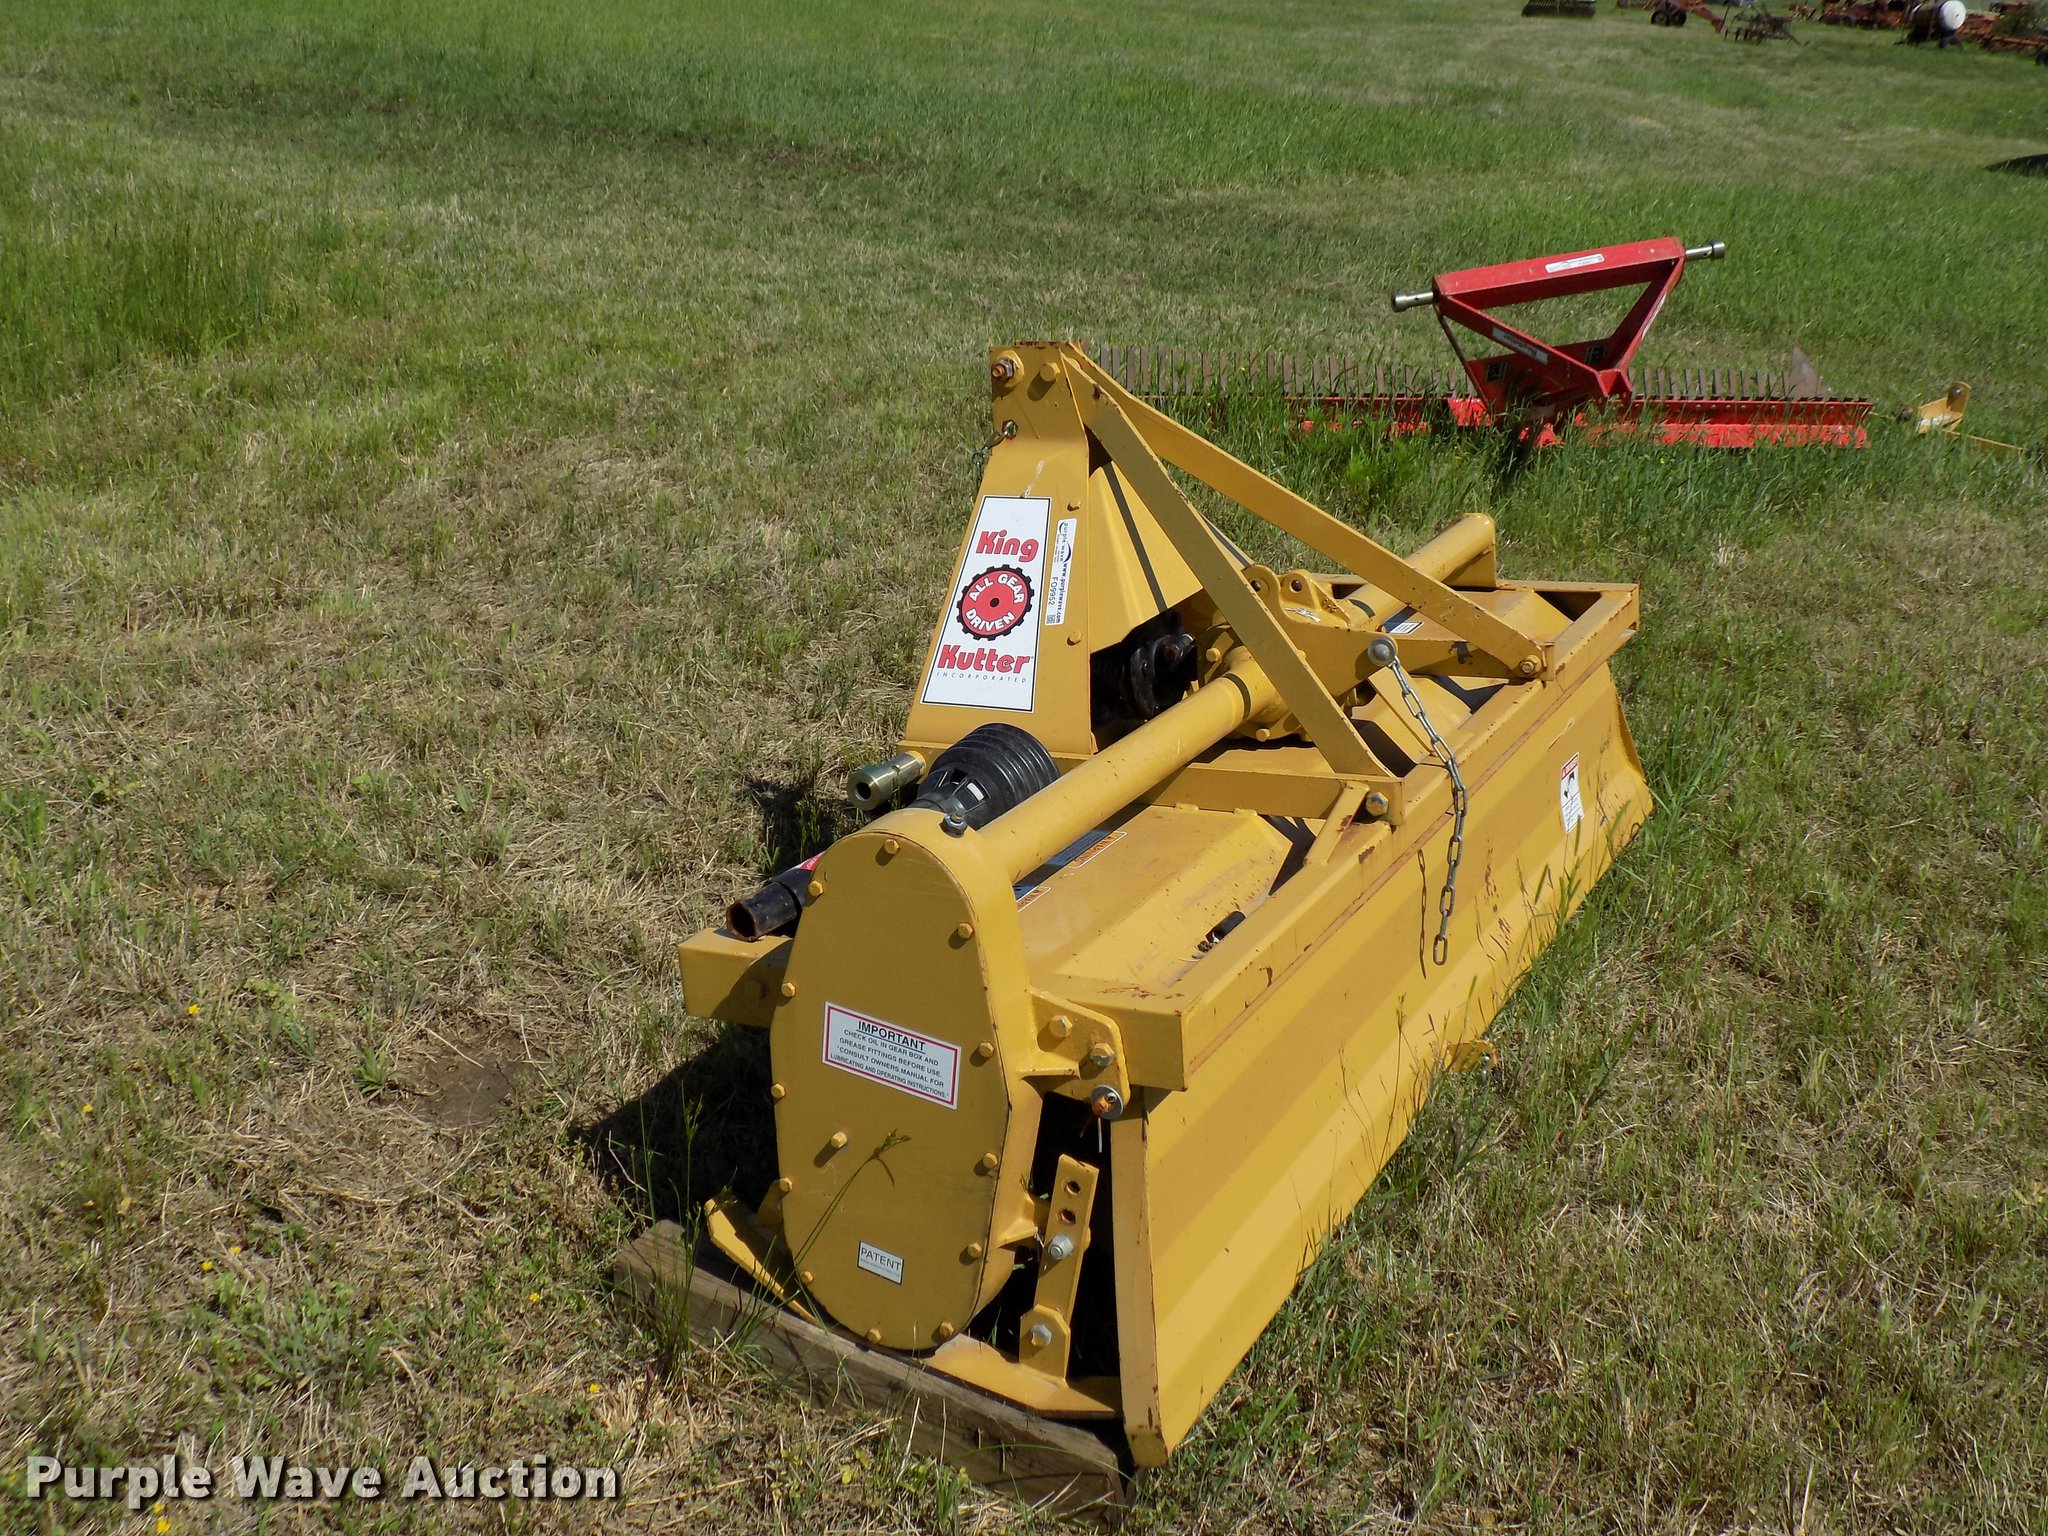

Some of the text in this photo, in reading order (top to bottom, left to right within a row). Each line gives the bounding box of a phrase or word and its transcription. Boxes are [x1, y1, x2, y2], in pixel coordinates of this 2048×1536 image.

[976, 530, 1039, 562] King
[969, 573, 1024, 604] ALL GEAR
[1055, 563, 1067, 623] www.purplewave.com
[965, 608, 1015, 632] DRIVEN
[937, 644, 1031, 674] Kutter
[936, 672, 1027, 683] INCORPORATED
[844, 1029, 939, 1066] CHECK OIL IN GEAR BOX AND
[857, 1021, 926, 1051] IMPORTANT
[830, 1053, 864, 1070] LUBRICATING
[865, 1065, 876, 1074] AND
[877, 1068, 906, 1085] OPERATING
[839, 1037, 866, 1051] GREASE
[868, 1046, 897, 1062] FITTINGS
[898, 1057, 925, 1072] BEFORE
[901, 1068, 928, 1083] MANUAL
[930, 1078, 944, 1088] FOR
[861, 1247, 901, 1271] PATENT
